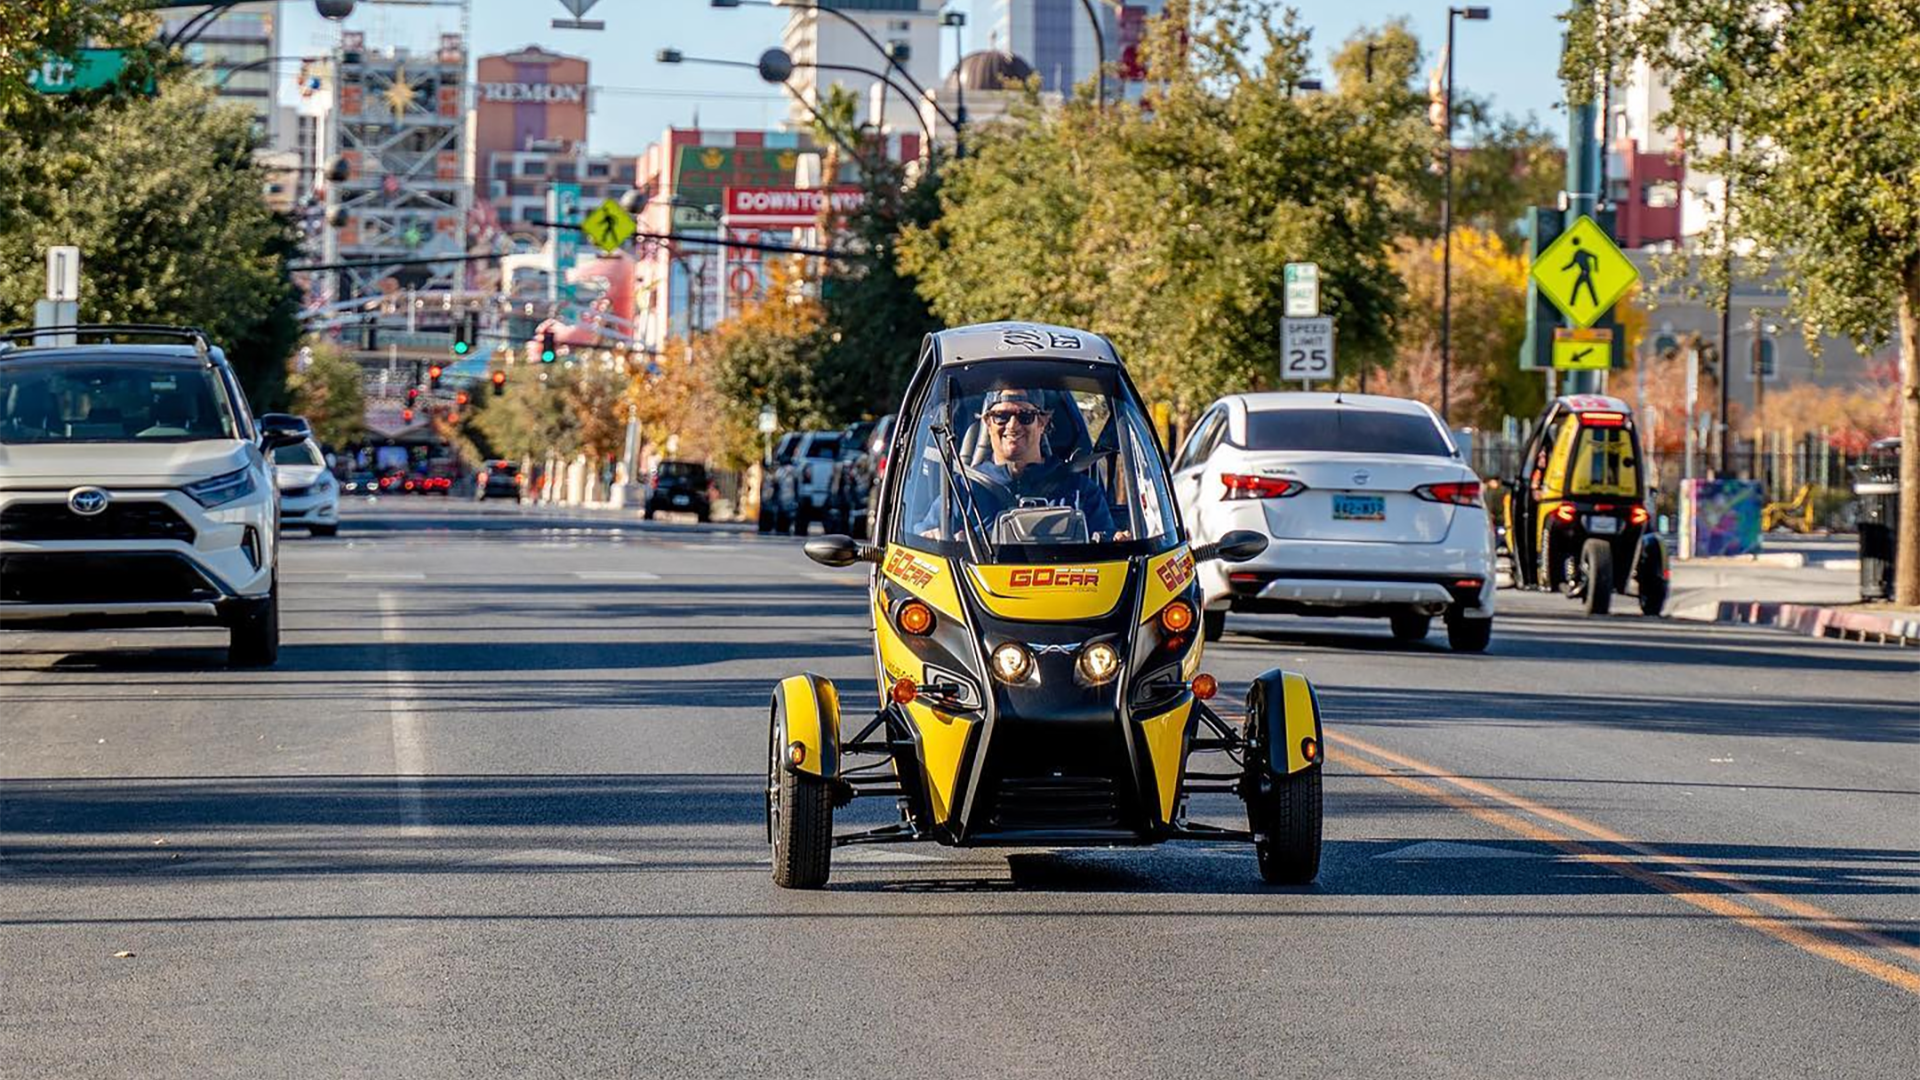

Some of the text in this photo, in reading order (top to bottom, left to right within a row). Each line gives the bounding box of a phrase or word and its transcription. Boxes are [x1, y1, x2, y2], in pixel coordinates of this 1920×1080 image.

[1289, 323, 1328, 334] SPEED
[1292, 337, 1323, 346] LIMIT
[1290, 350, 1327, 371] 25
